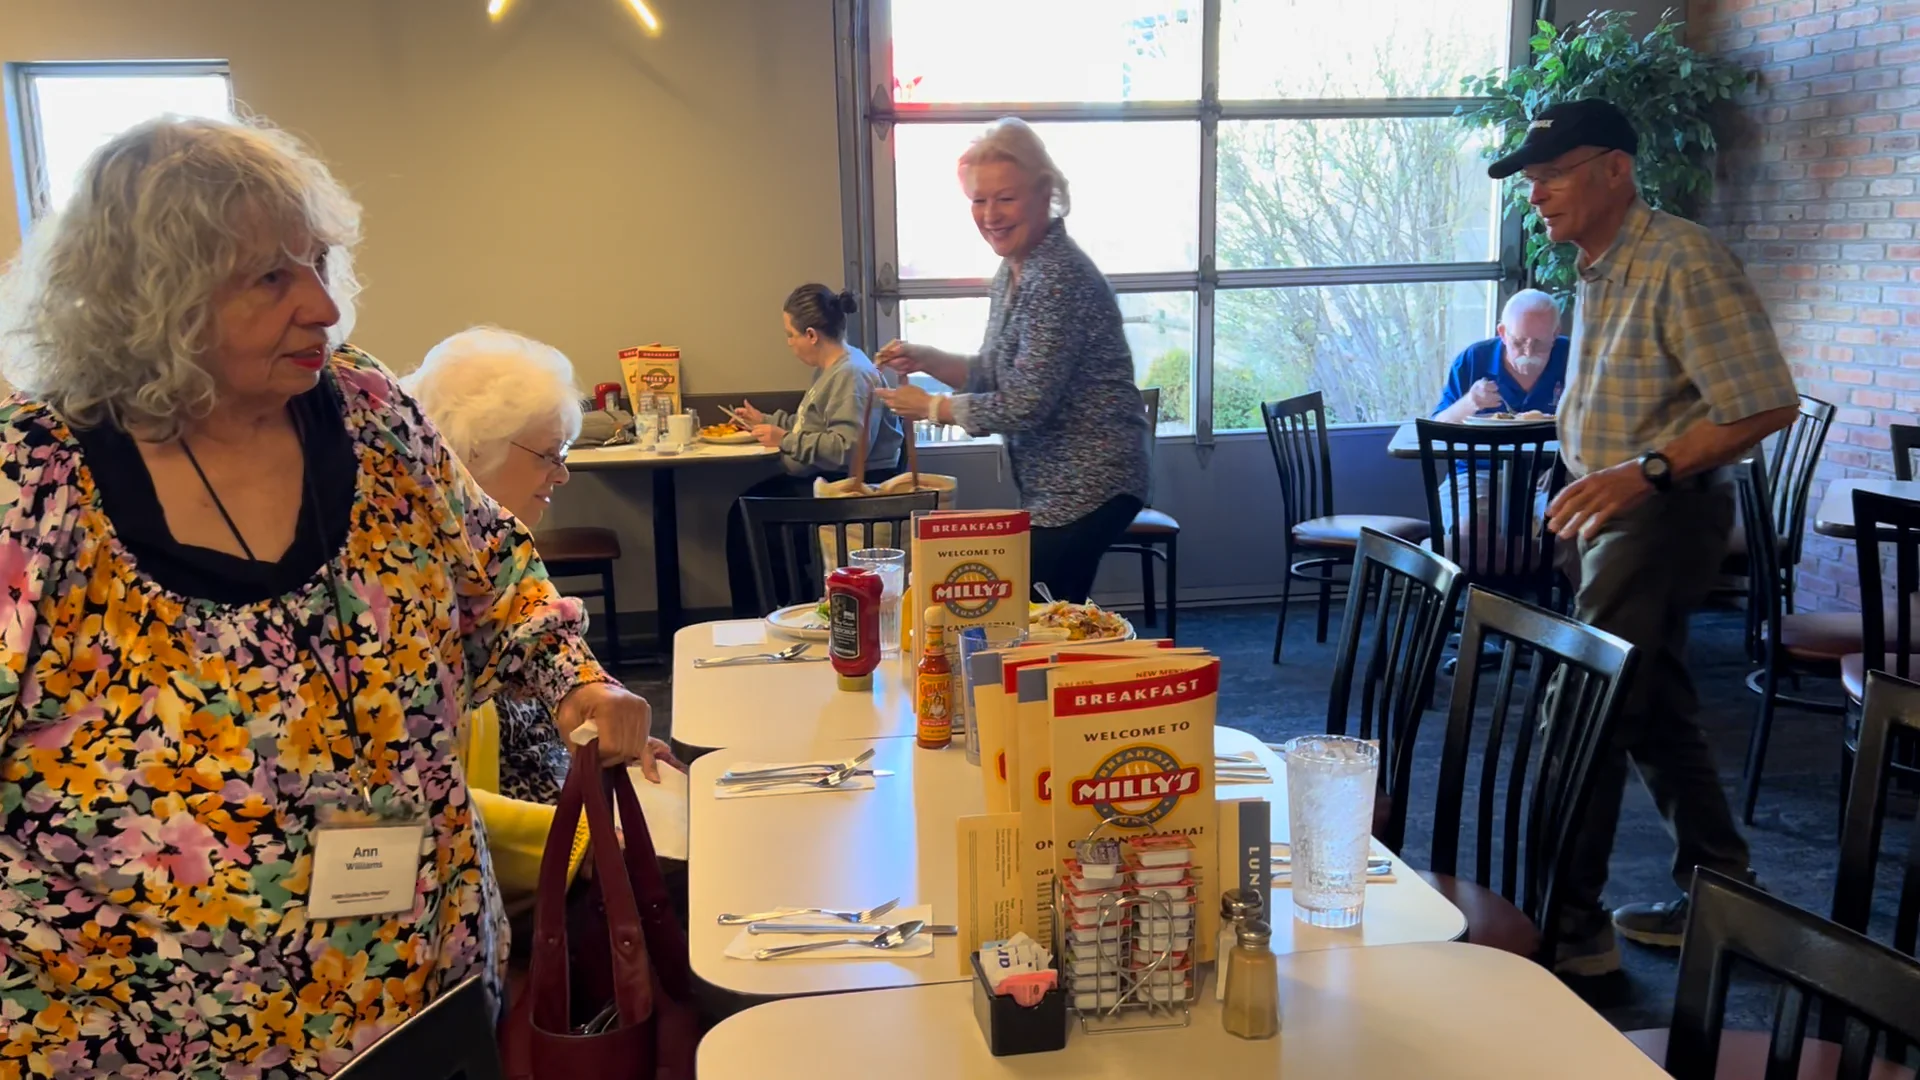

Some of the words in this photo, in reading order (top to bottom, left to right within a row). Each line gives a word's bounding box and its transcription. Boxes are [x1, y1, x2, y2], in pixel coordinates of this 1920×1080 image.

[932, 521, 1012, 533] BREAKFAST
[938, 548, 989, 558] WELCOME
[935, 583, 1009, 600] MILLY'S
[1136, 669, 1157, 679] NEW
[1075, 678, 1200, 706] BREAKFAST
[1084, 724, 1166, 742] WELCOME
[1170, 721, 1190, 732] TO
[1099, 750, 1176, 778] BREAKFAST
[1078, 771, 1196, 801] MILLY'S
[352, 846, 379, 859] Ann
